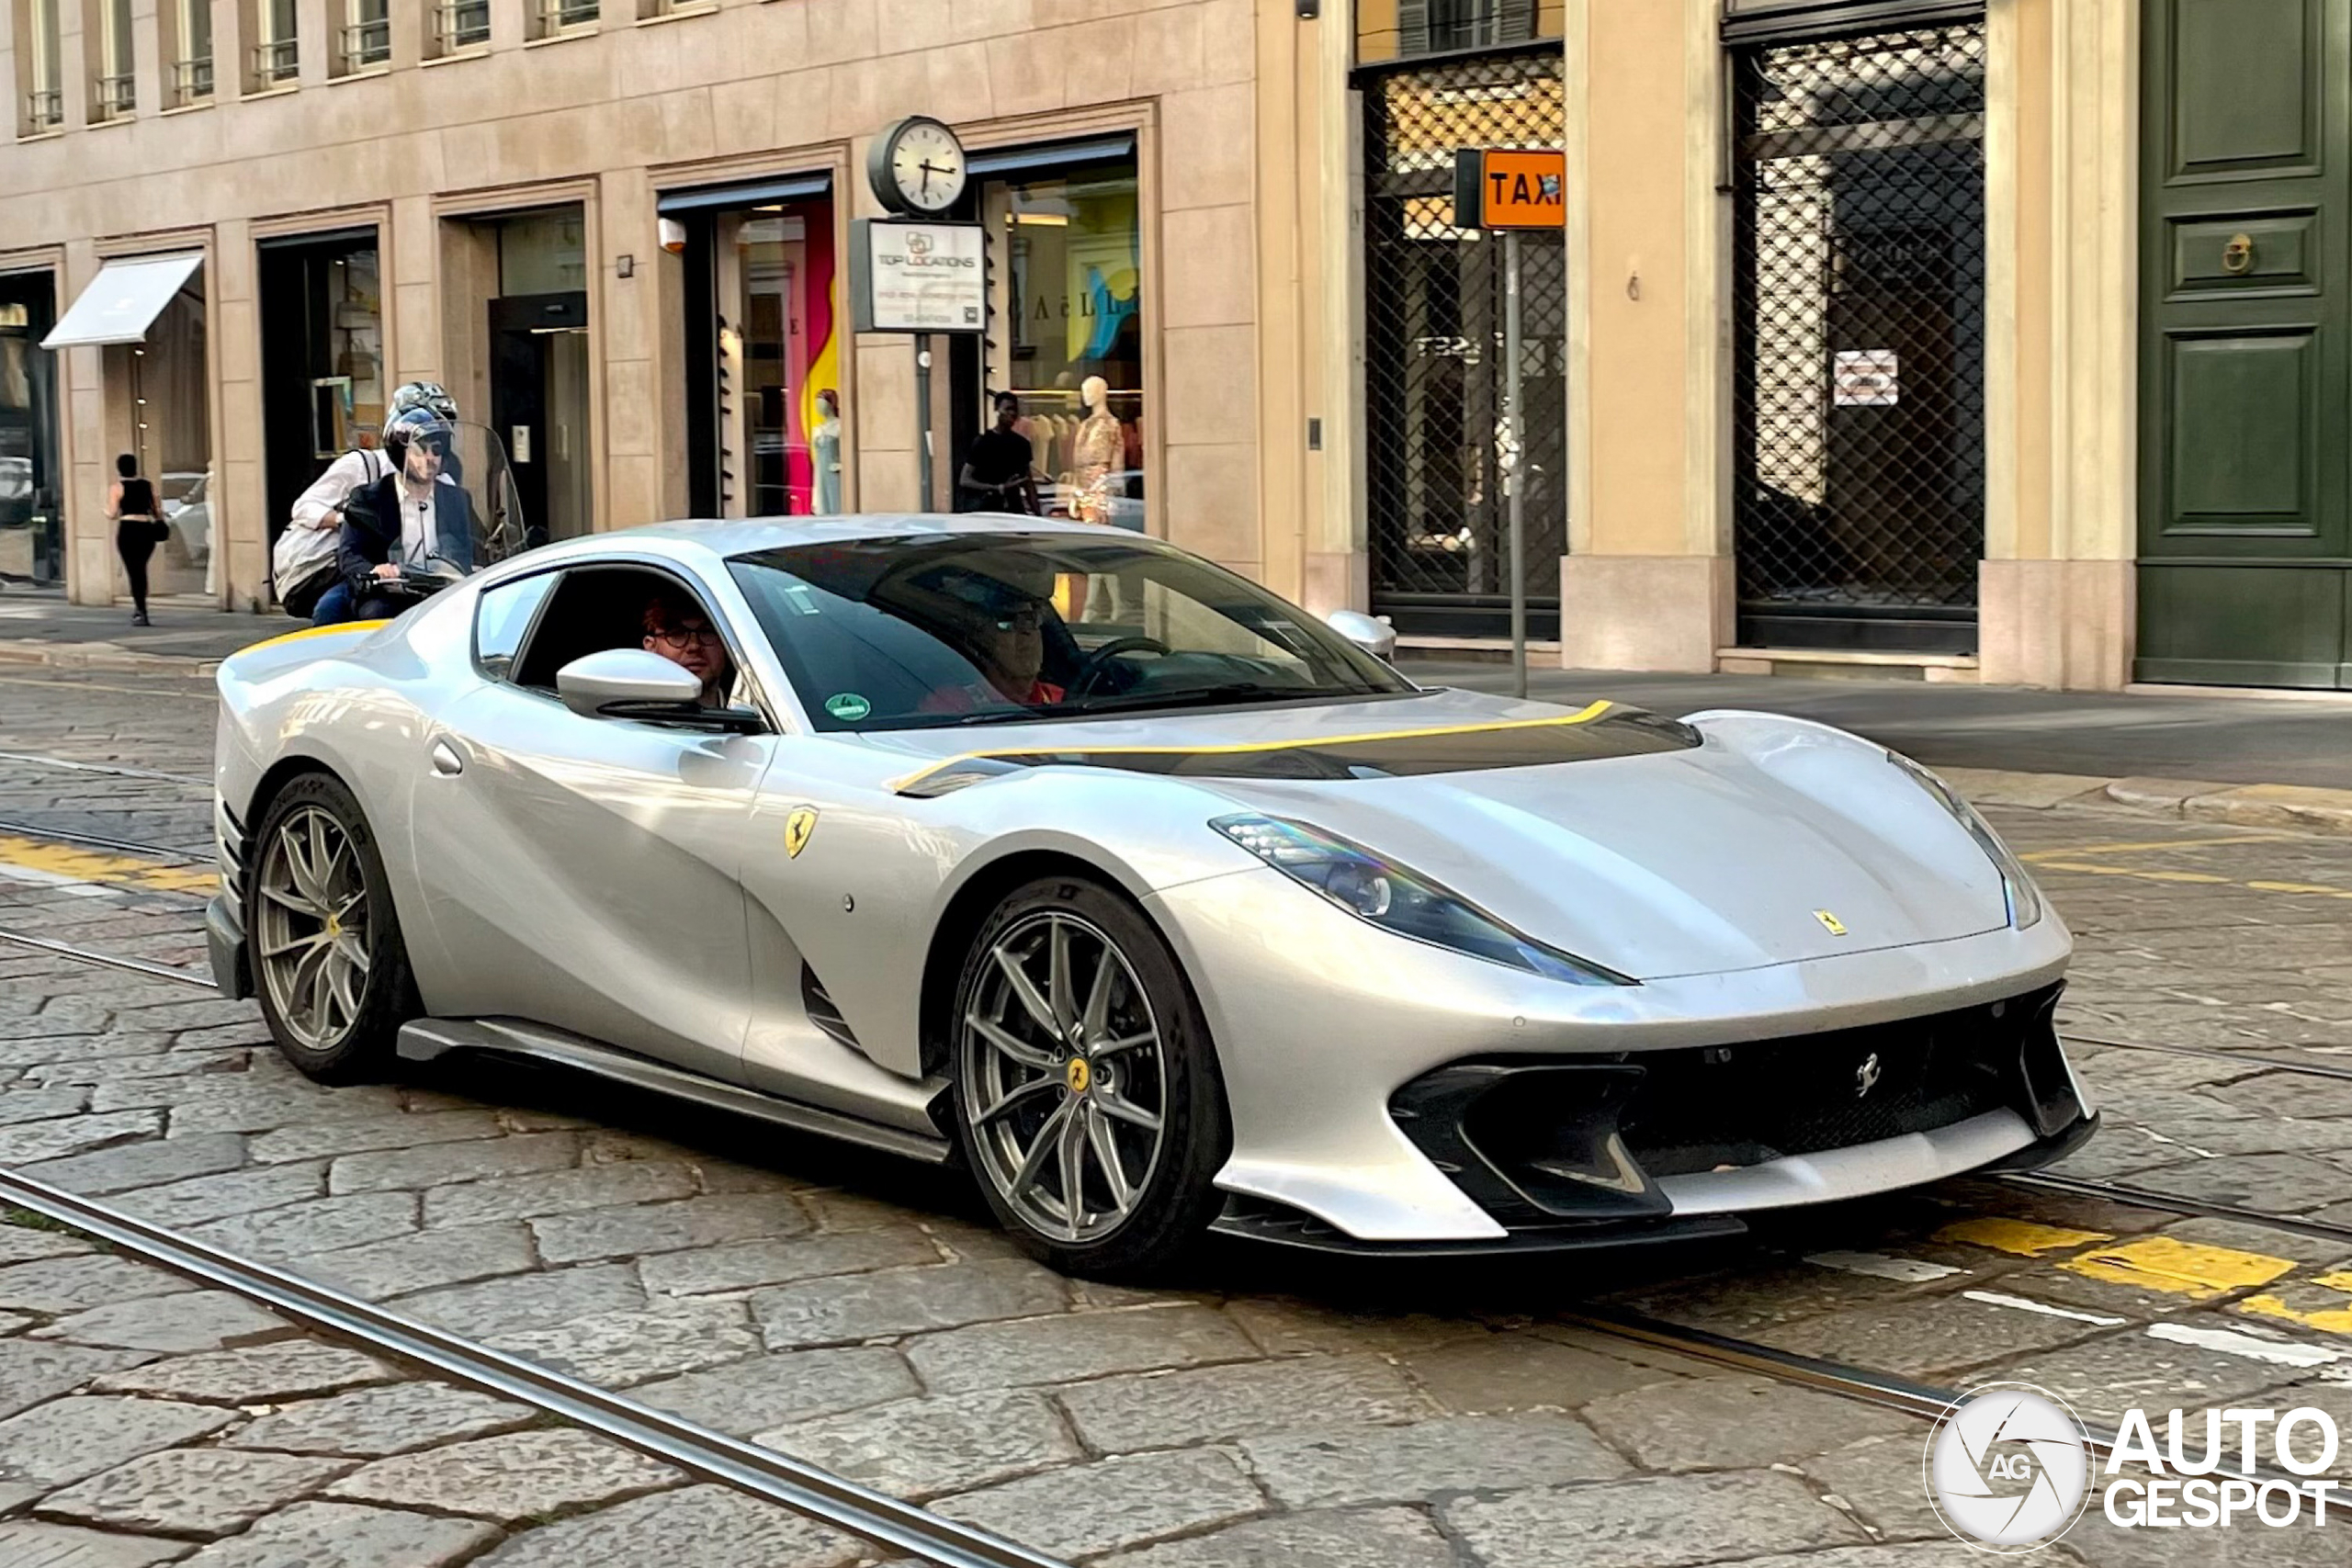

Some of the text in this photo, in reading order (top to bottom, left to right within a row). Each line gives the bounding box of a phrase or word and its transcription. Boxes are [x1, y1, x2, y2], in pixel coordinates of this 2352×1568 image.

[1489, 173, 1561, 205] TAXI
[878, 254, 976, 267] TOP LOCATIONS
